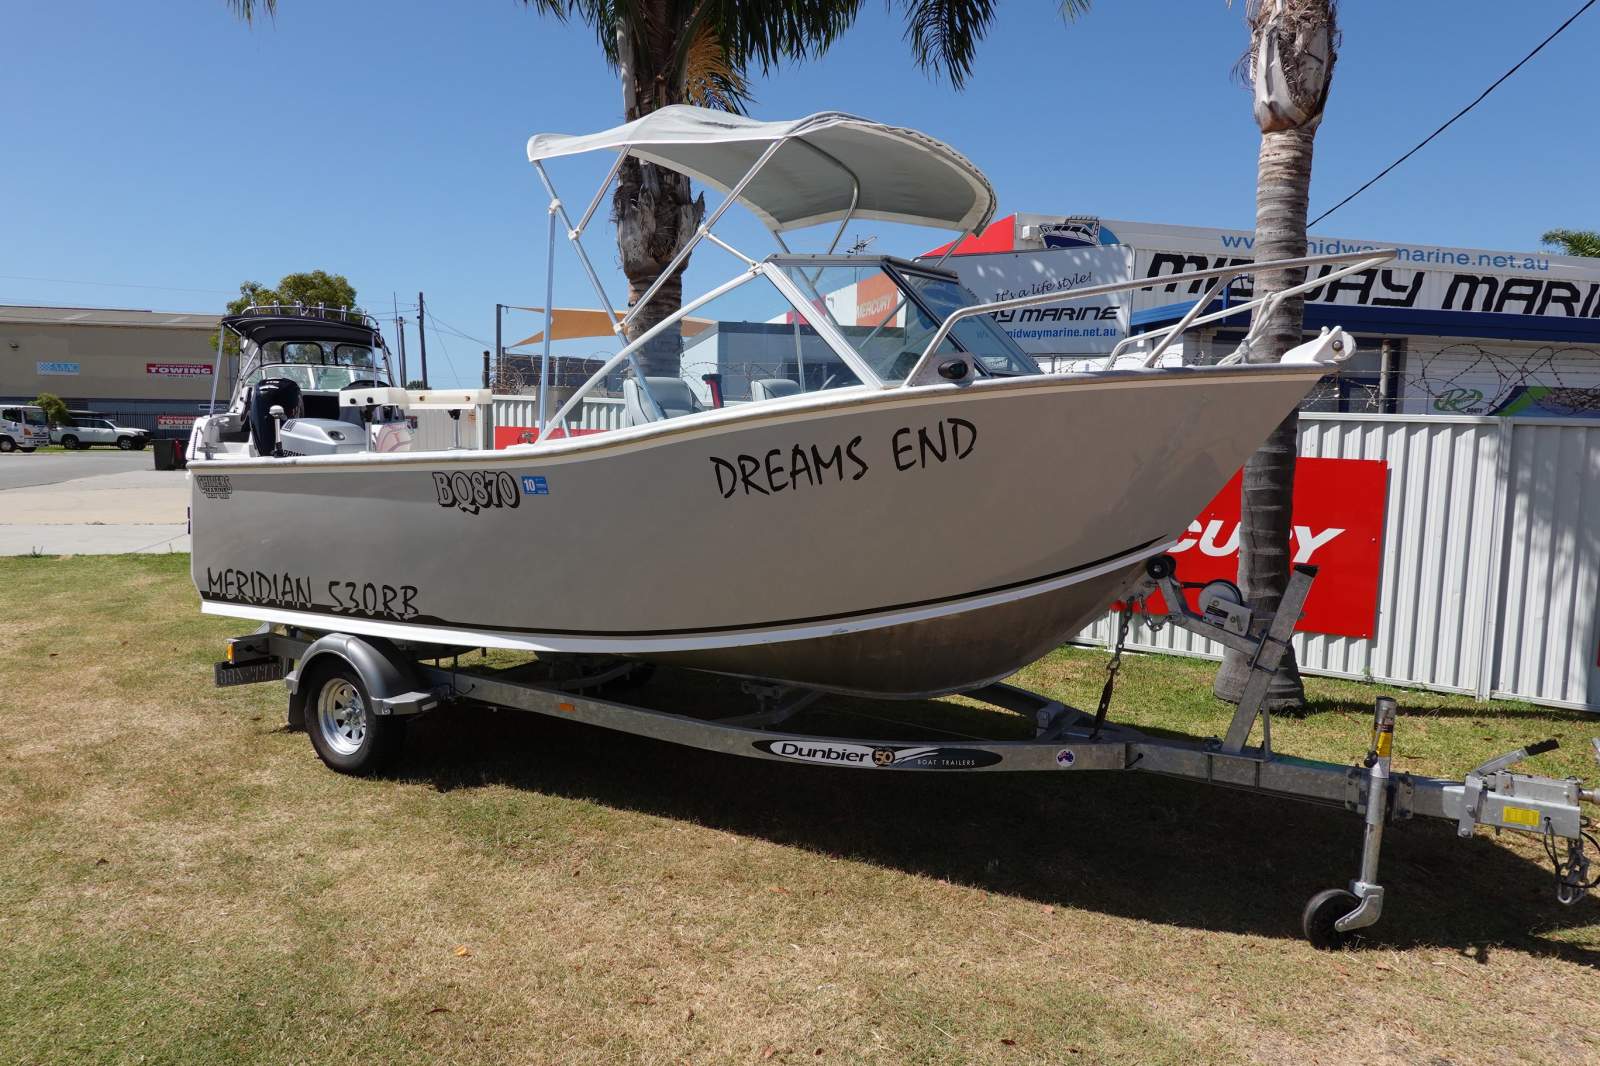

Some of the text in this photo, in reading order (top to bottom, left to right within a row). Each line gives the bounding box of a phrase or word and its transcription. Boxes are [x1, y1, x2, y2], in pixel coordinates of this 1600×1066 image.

[1032, 280, 1055, 296] life
[1441, 275, 1600, 318] MARI
[1019, 306, 1121, 322] MARINE
[710, 417, 978, 499] DREAMS END
[431, 470, 521, 516] BQ870
[524, 479, 535, 491] 10
[1166, 519, 1347, 564] CUY
[207, 567, 313, 609] MERIDIAN
[781, 743, 869, 763] Dunbier
[874, 750, 893, 765] 50
[917, 759, 937, 767] BOAT
